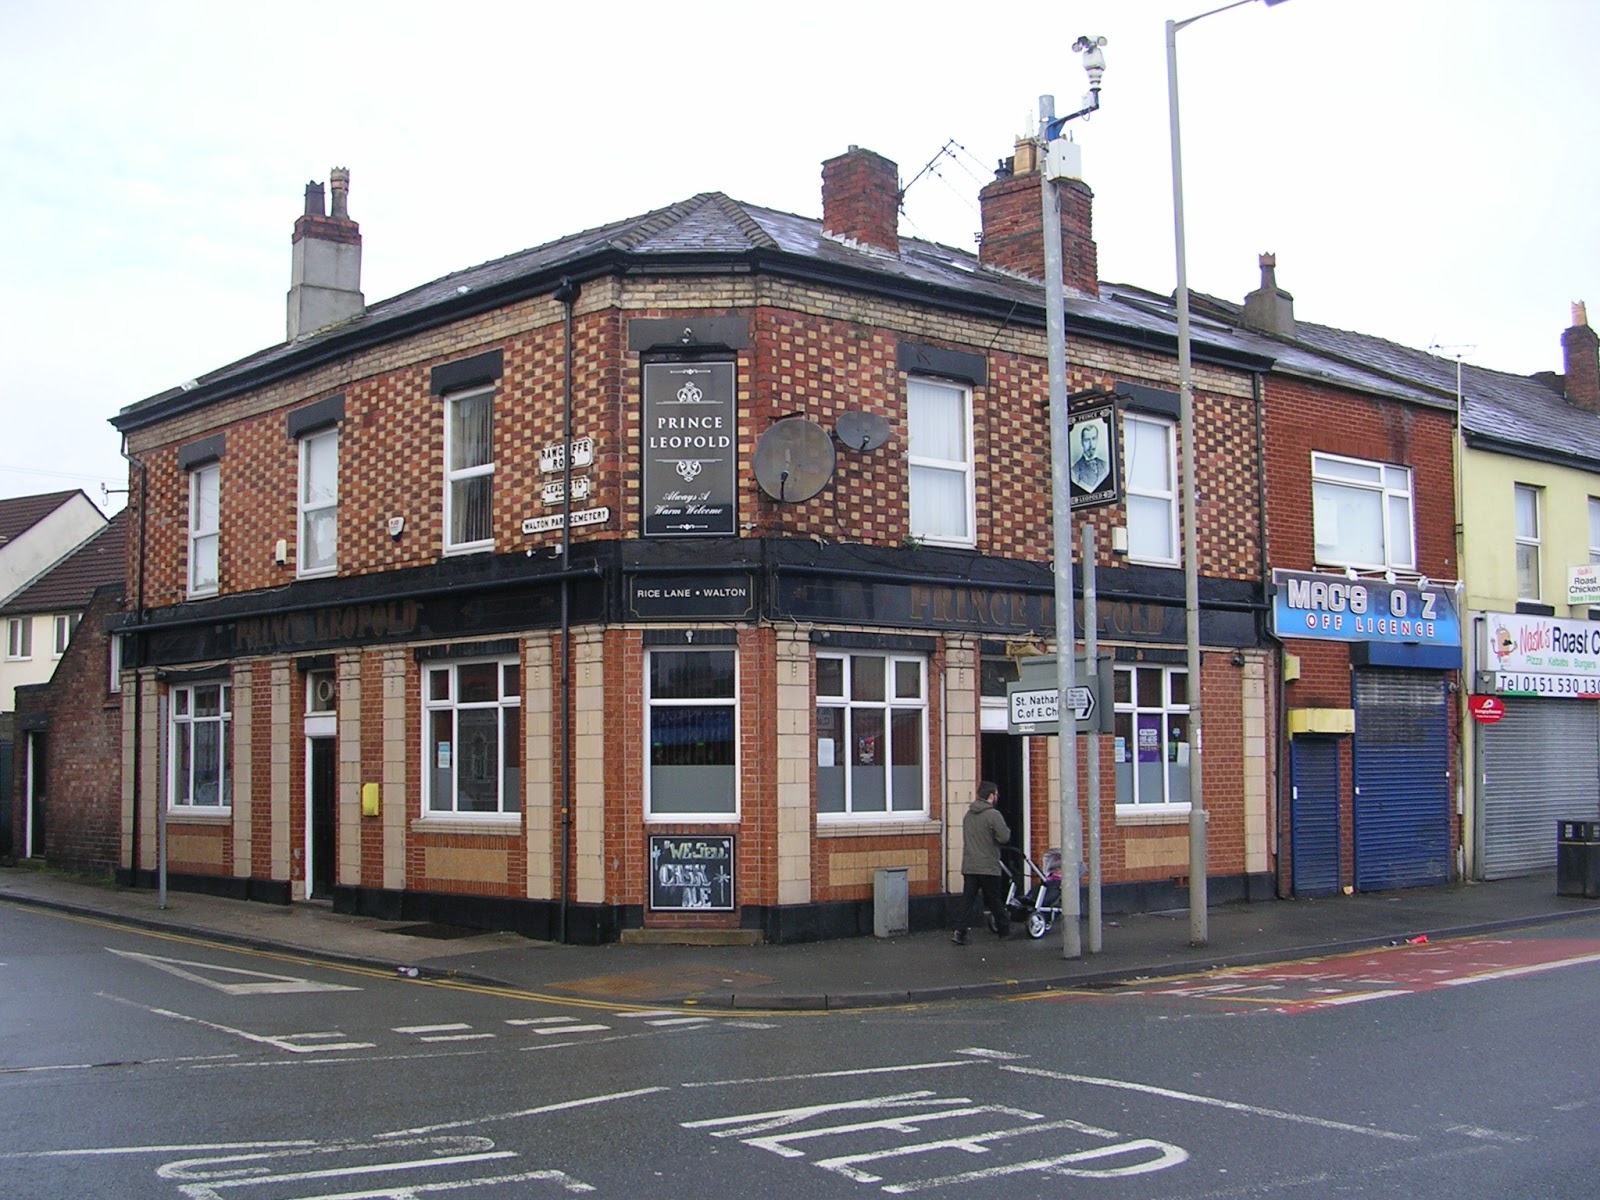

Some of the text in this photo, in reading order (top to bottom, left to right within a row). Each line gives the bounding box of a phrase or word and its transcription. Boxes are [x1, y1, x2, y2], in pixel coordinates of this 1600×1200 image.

[657, 416, 723, 429] PRINCE
[650, 435, 731, 449] LEOPOLD
[541, 442, 588, 459] RAWCFFE
[553, 456, 575, 468] ROD
[546, 480, 582, 494] LEAD TO
[662, 489, 697, 504] Always
[654, 504, 724, 516] Warm Welcome
[524, 510, 607, 531] WALTON PAR CEMETERY
[1574, 576, 1597, 585] Roast
[637, 588, 747, 598] RICE LANE WALTON
[1288, 578, 1368, 614] MAC'S
[910, 583, 1165, 635] PRINCE LOPOLD
[1306, 612, 1435, 637] OFF LICENCE
[1552, 626, 1588, 654] Roast
[1526, 655, 1543, 666] Pizza
[1574, 658, 1597, 670] Burgers
[1500, 675, 1519, 691] Tel
[1523, 676, 1554, 692] 0151
[1558, 677, 1579, 693] 530
[679, 1090, 1190, 1194] KEEP
